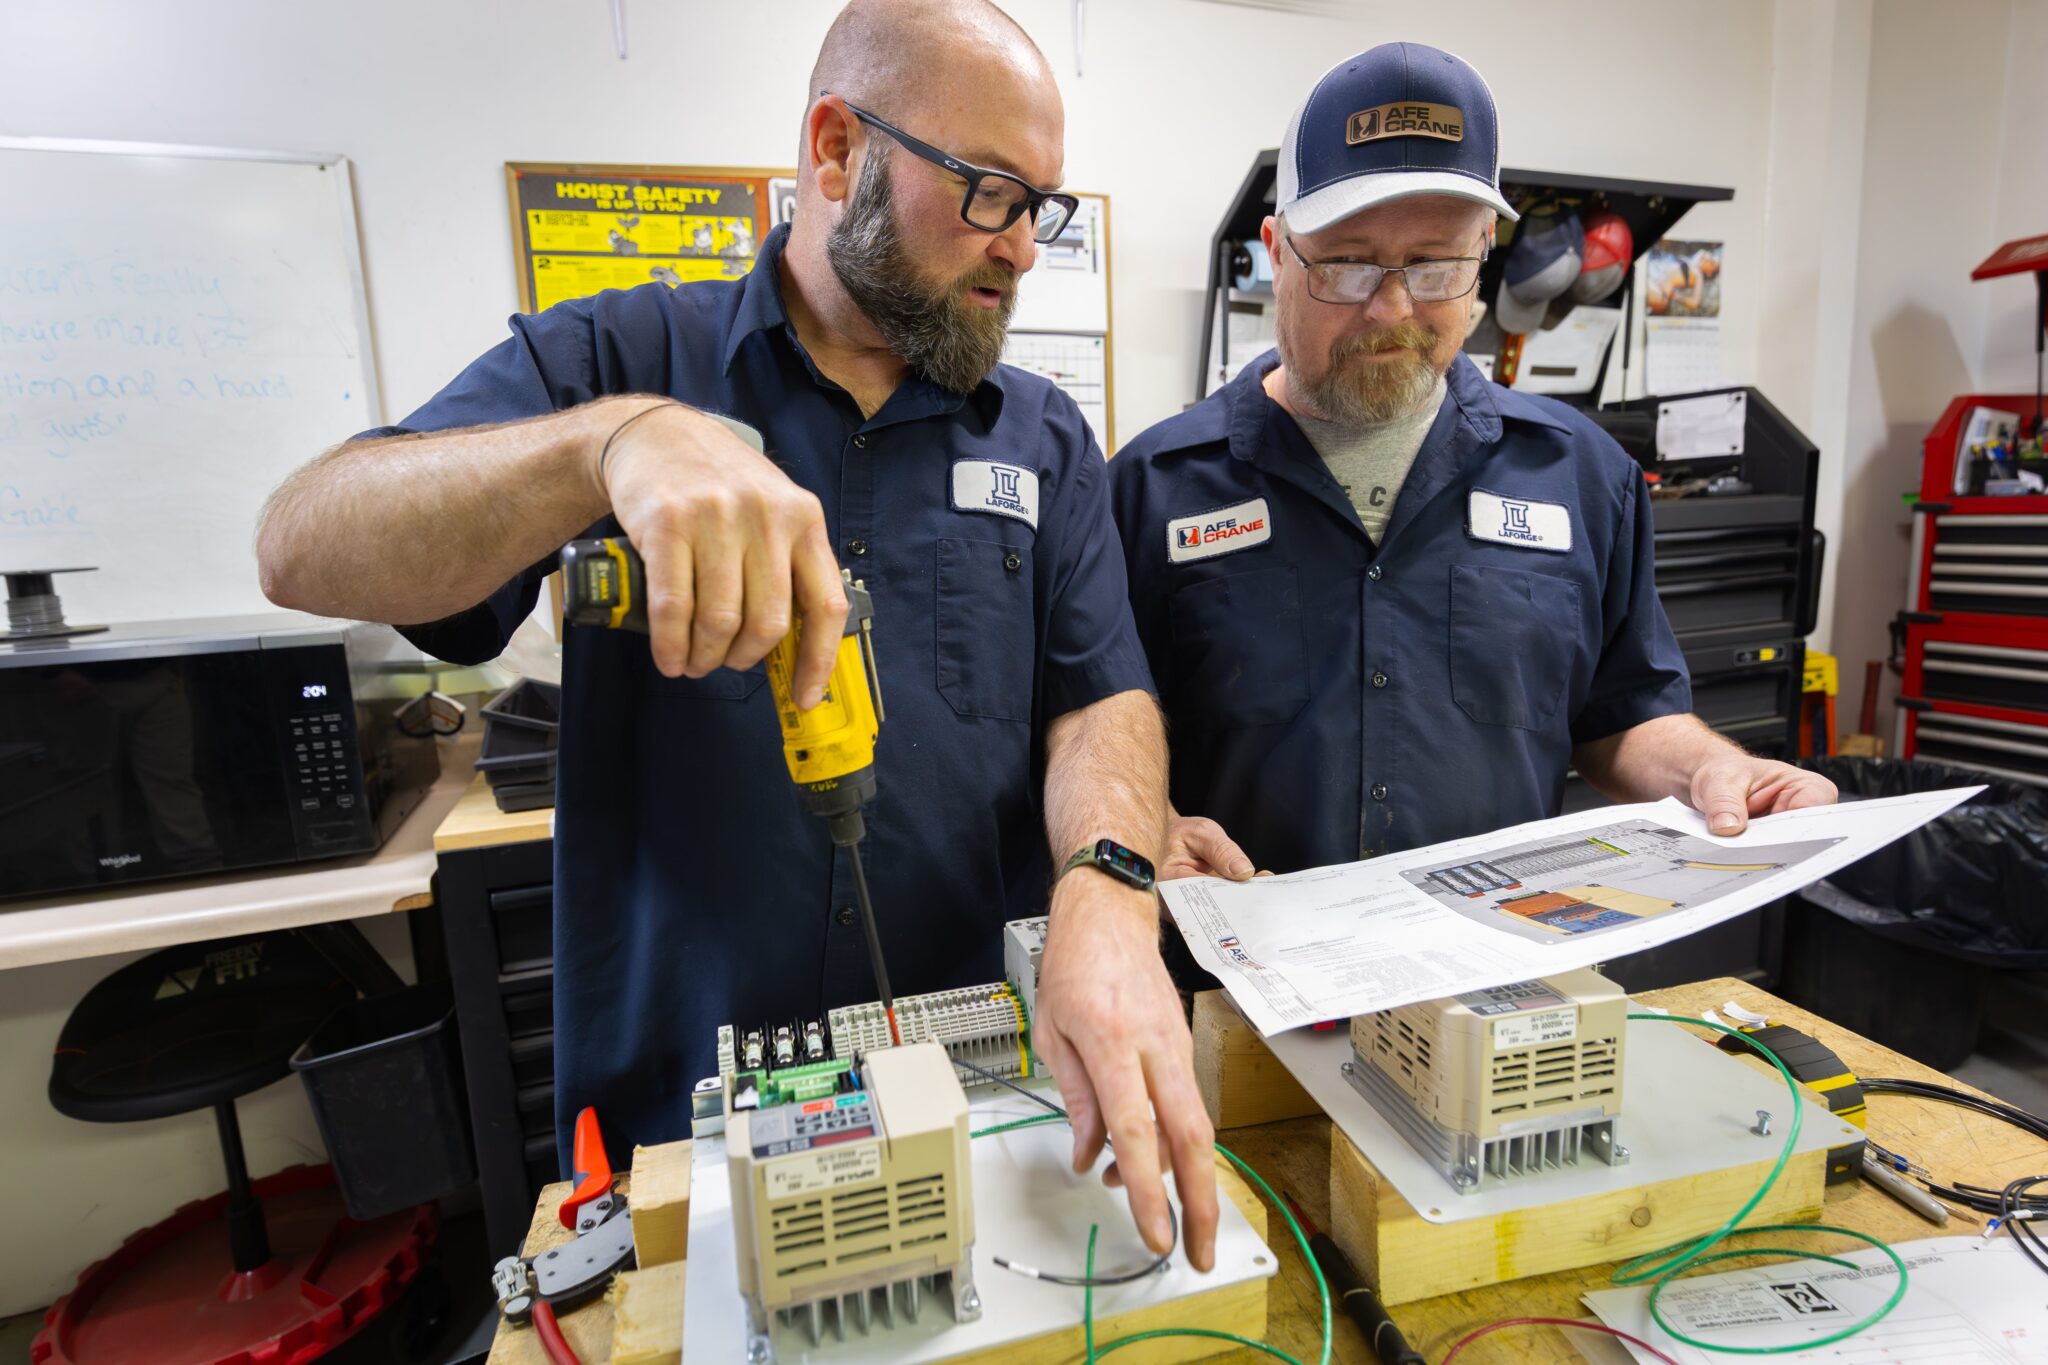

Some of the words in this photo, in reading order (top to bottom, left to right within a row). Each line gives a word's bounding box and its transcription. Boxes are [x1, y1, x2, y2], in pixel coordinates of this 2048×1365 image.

[1385, 106, 1430, 121] AFE
[1384, 120, 1461, 137] CRANE
[556, 182, 628, 201] HOIST
[632, 186, 722, 205] SAFETY
[596, 199, 612, 209] IS
[613, 200, 634, 210] UP
[636, 201, 656, 211] TO
[657, 202, 686, 213] YOU
[532, 214, 541, 225] 1
[537, 258, 551, 269] 2
[86, 370, 159, 402] and
[175, 378, 208, 401] a
[213, 374, 293, 402] hard
[1203, 519, 1264, 543] CRANE
[1204, 519, 1237, 534] AFE
[214, 957, 260, 985] FIT
